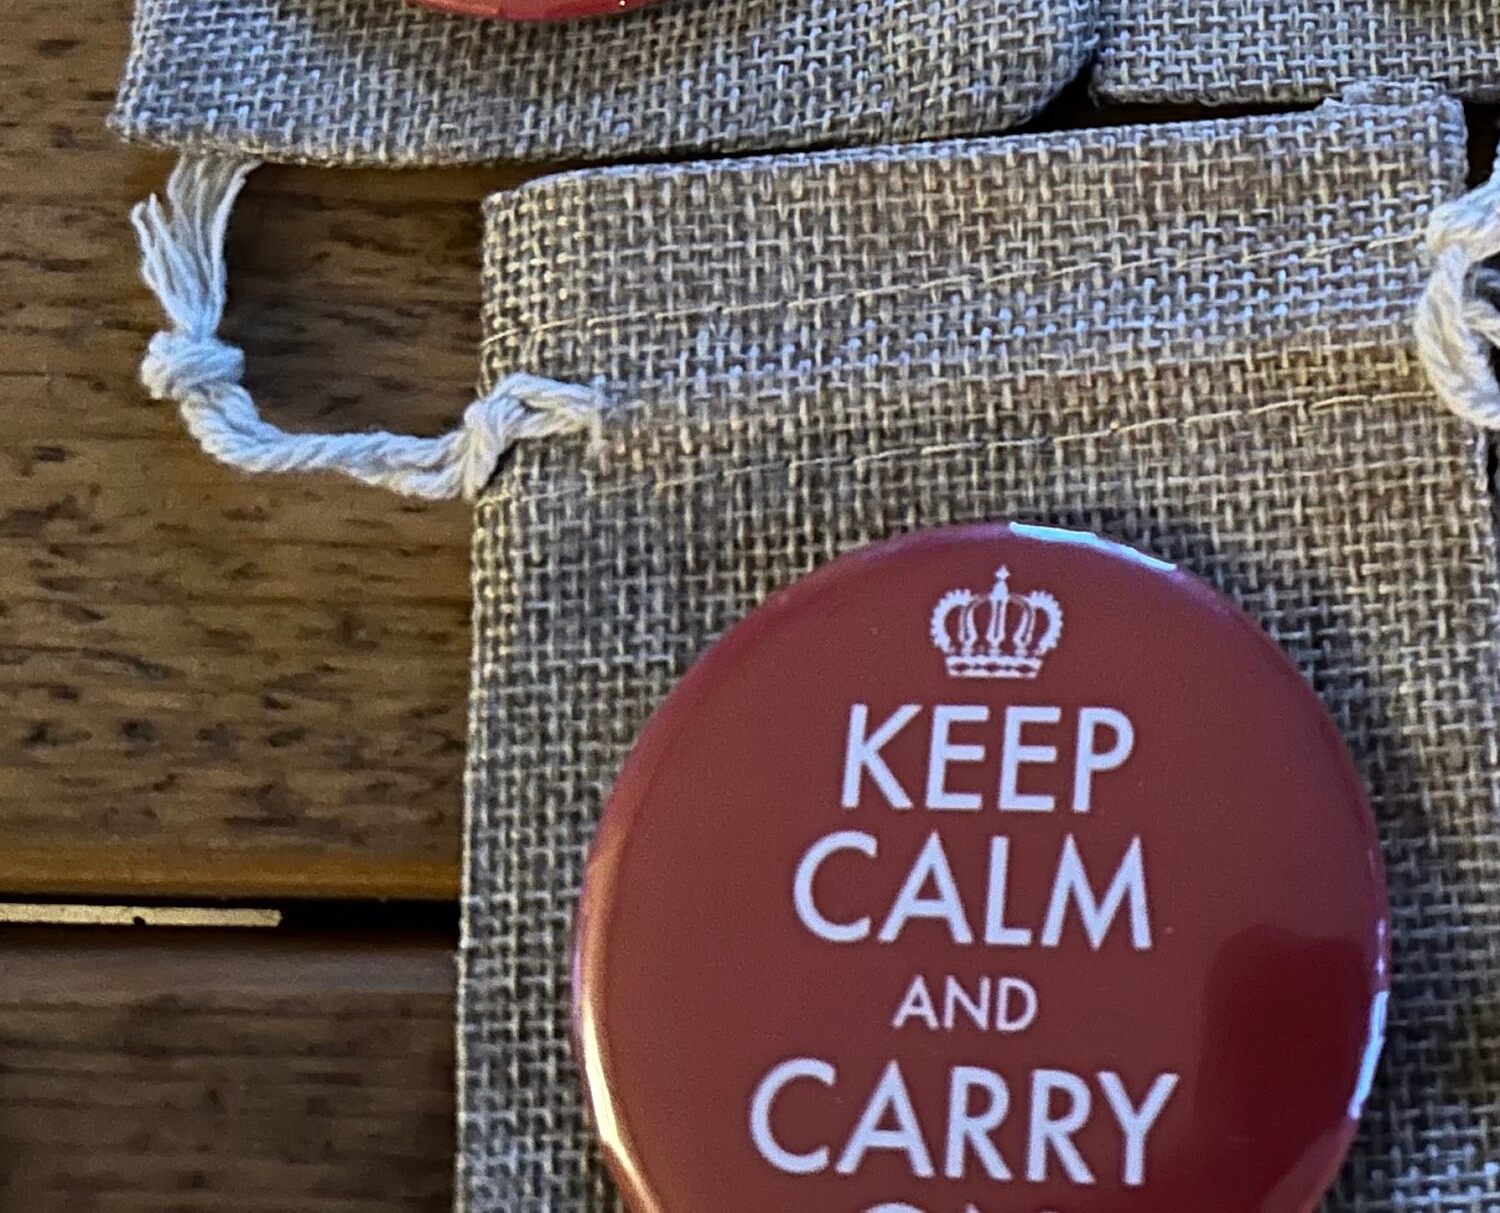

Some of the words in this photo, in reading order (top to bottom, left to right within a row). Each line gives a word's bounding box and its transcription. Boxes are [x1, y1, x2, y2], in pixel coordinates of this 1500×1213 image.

[839, 701, 1136, 815] KEEP
[791, 828, 1155, 952] CALM
[890, 974, 1040, 1034] AND
[748, 1056, 1181, 1187] CARRY
